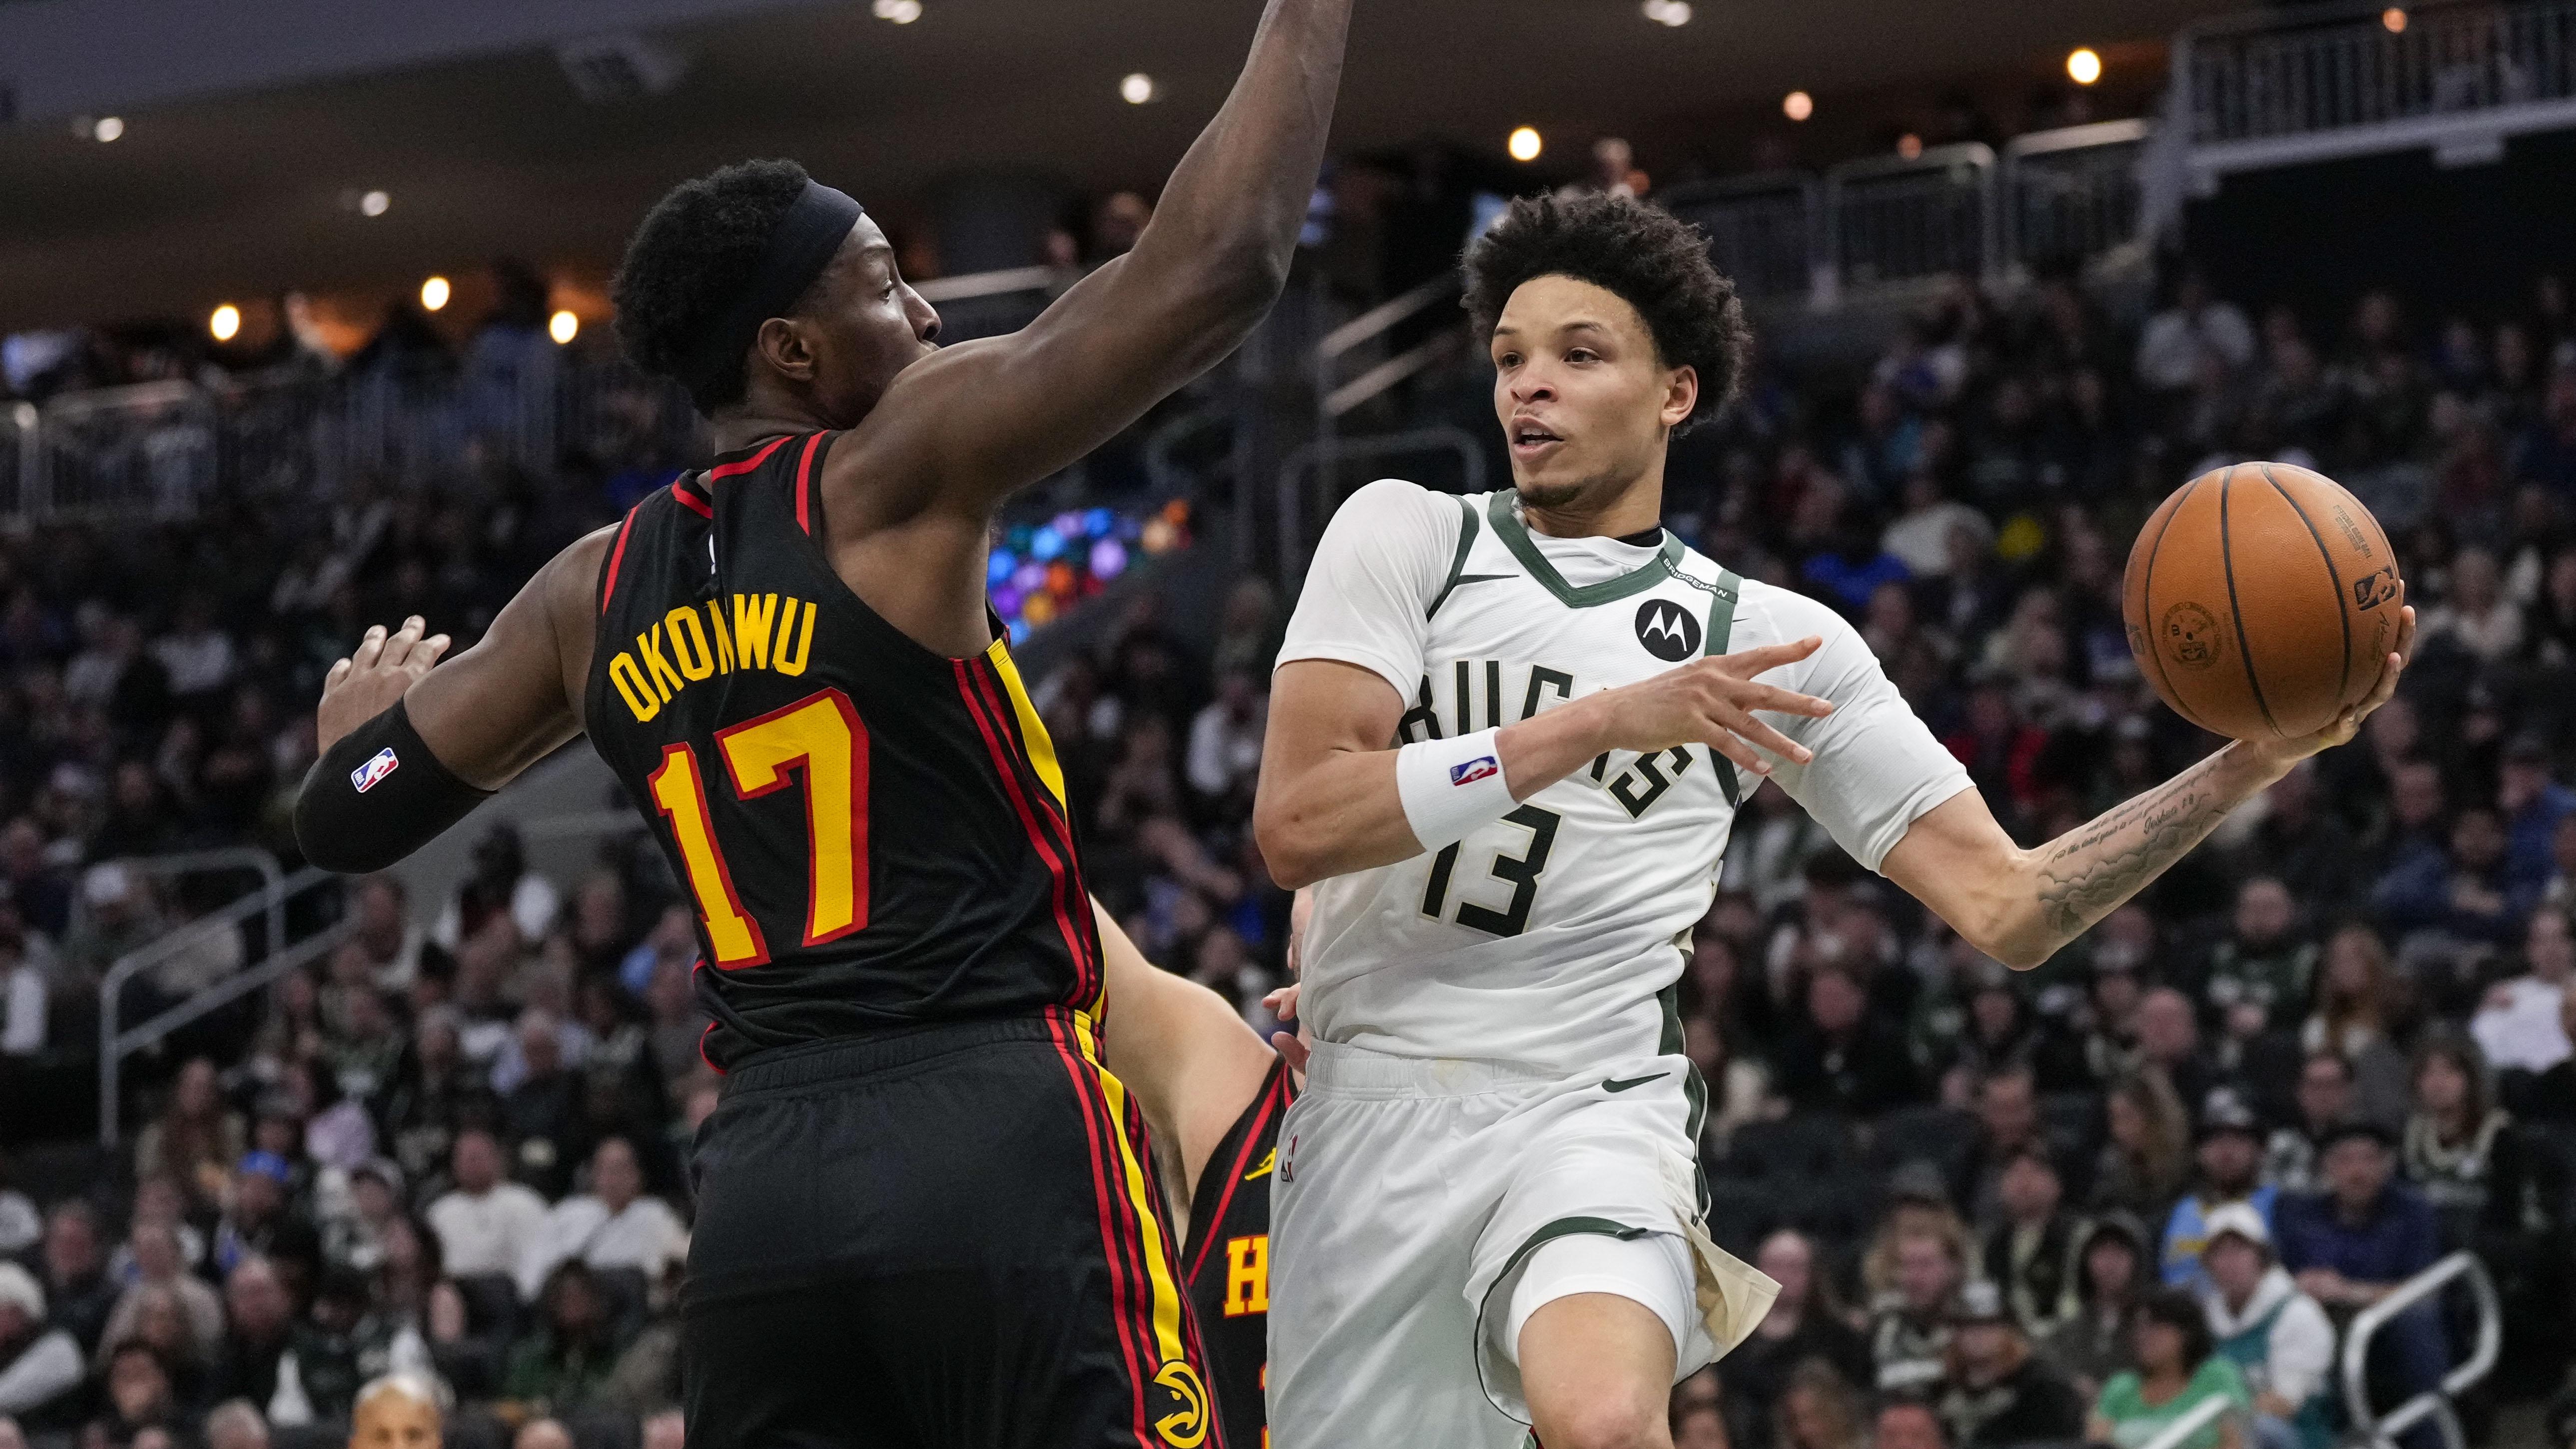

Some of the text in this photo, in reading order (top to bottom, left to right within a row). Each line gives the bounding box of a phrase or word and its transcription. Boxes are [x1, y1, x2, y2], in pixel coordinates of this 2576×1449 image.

[1663, 558, 1728, 597] BRIDGEMAN
[354, 771, 365, 784] NBA
[647, 686, 869, 970] 17
[1417, 800, 1567, 938] 13
